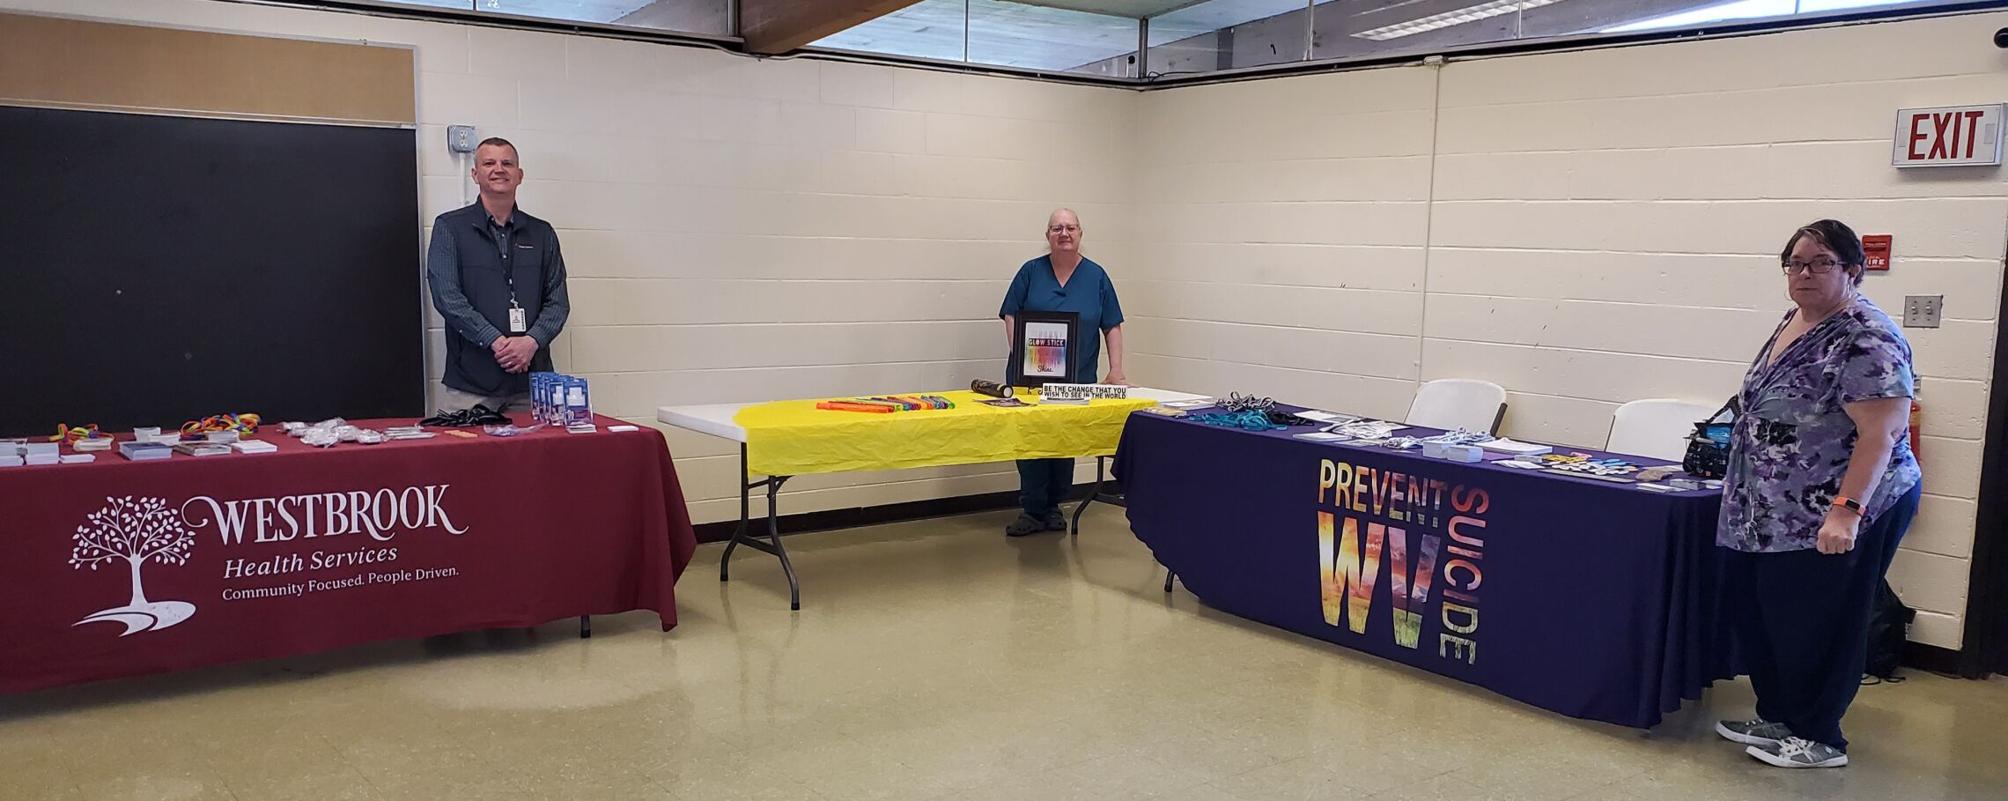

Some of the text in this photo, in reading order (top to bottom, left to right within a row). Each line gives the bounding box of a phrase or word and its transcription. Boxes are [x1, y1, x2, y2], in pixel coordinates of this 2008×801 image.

[1908, 111, 1984, 160] EXIT
[1047, 339, 1064, 347] STICK
[182, 484, 469, 545] WESTBROOK
[1318, 458, 1448, 528] PREVENT
[222, 566, 460, 601] Community Focused. People Driven.
[223, 546, 398, 579] Health Services
[1317, 511, 1441, 649] WV
[1439, 484, 1489, 665] SUICIDE
